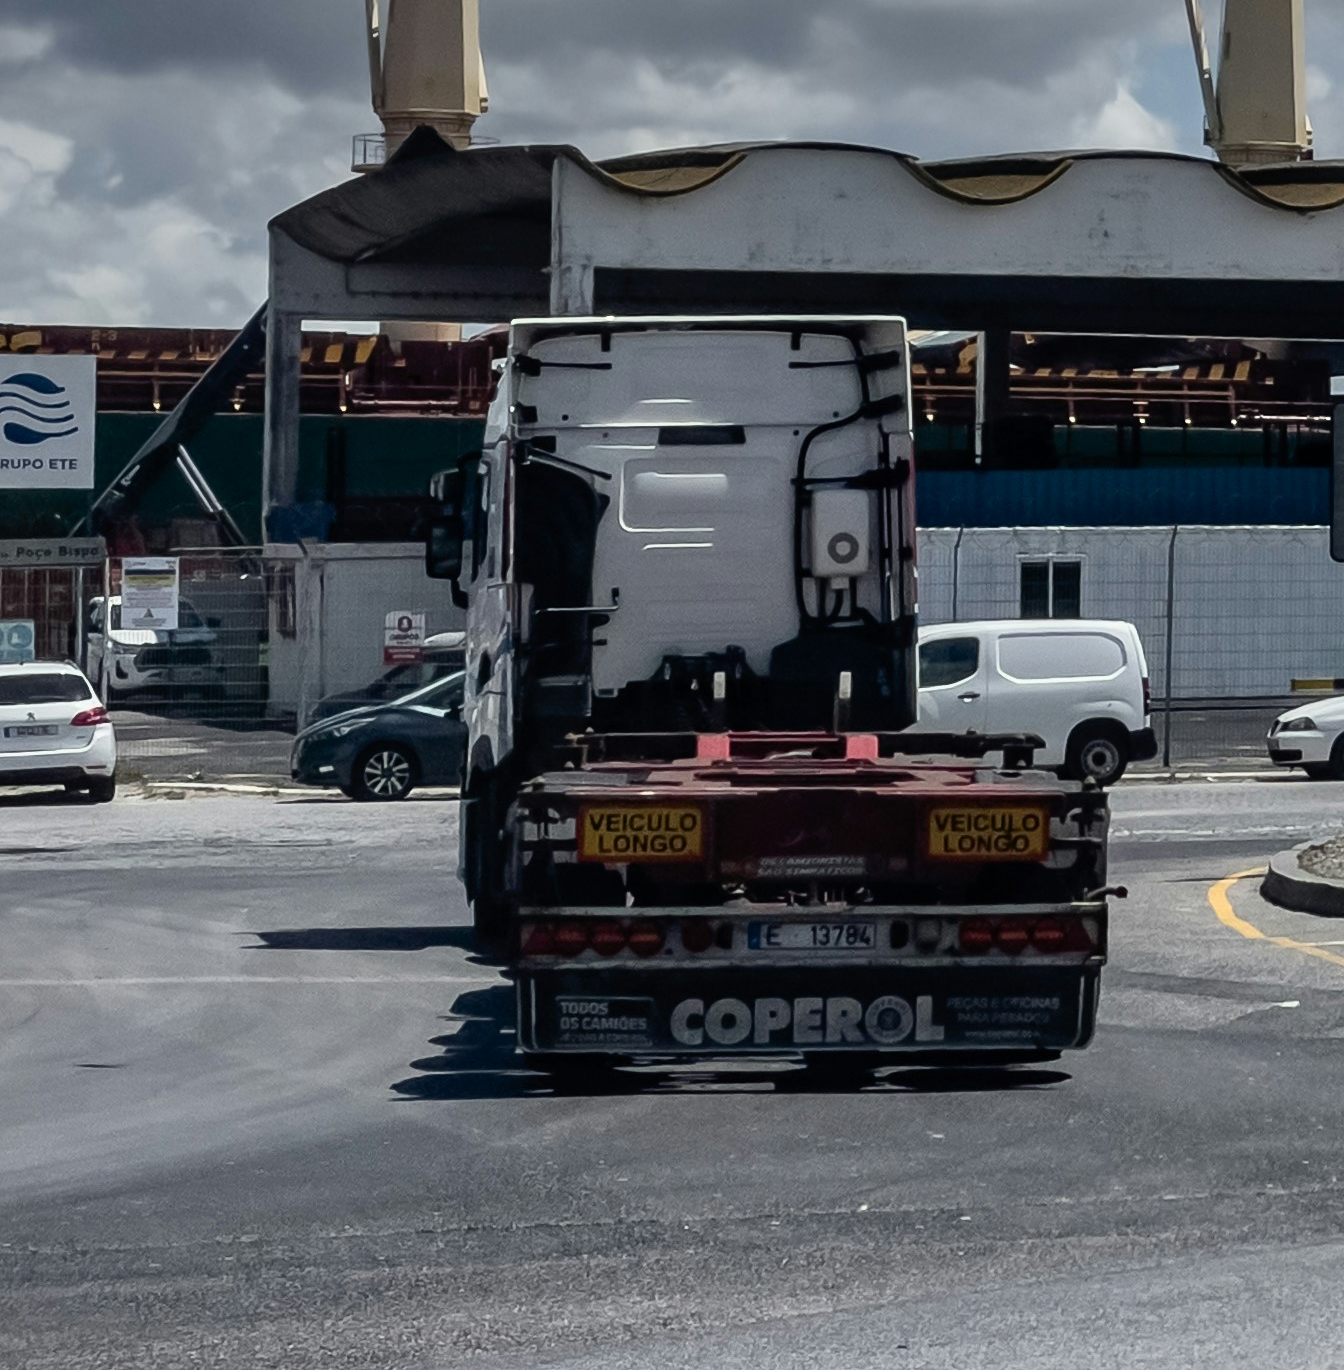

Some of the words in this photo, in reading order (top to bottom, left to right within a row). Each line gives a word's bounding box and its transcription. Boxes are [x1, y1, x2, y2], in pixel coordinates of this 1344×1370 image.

[0, 459, 43, 469] RUPO
[49, 459, 78, 470] ETE
[58, 546, 99, 559] Bispo
[589, 813, 697, 832] VEICULO
[935, 813, 1039, 832] VEICULO
[599, 834, 687, 853] LONGO
[944, 834, 1029, 852] LONGO
[811, 925, 870, 946] 13784
[560, 1001, 608, 1014] TODOS
[947, 997, 988, 1010] PEÇAS
[560, 1017, 579, 1030] OS
[670, 995, 945, 1045] COPEROL
